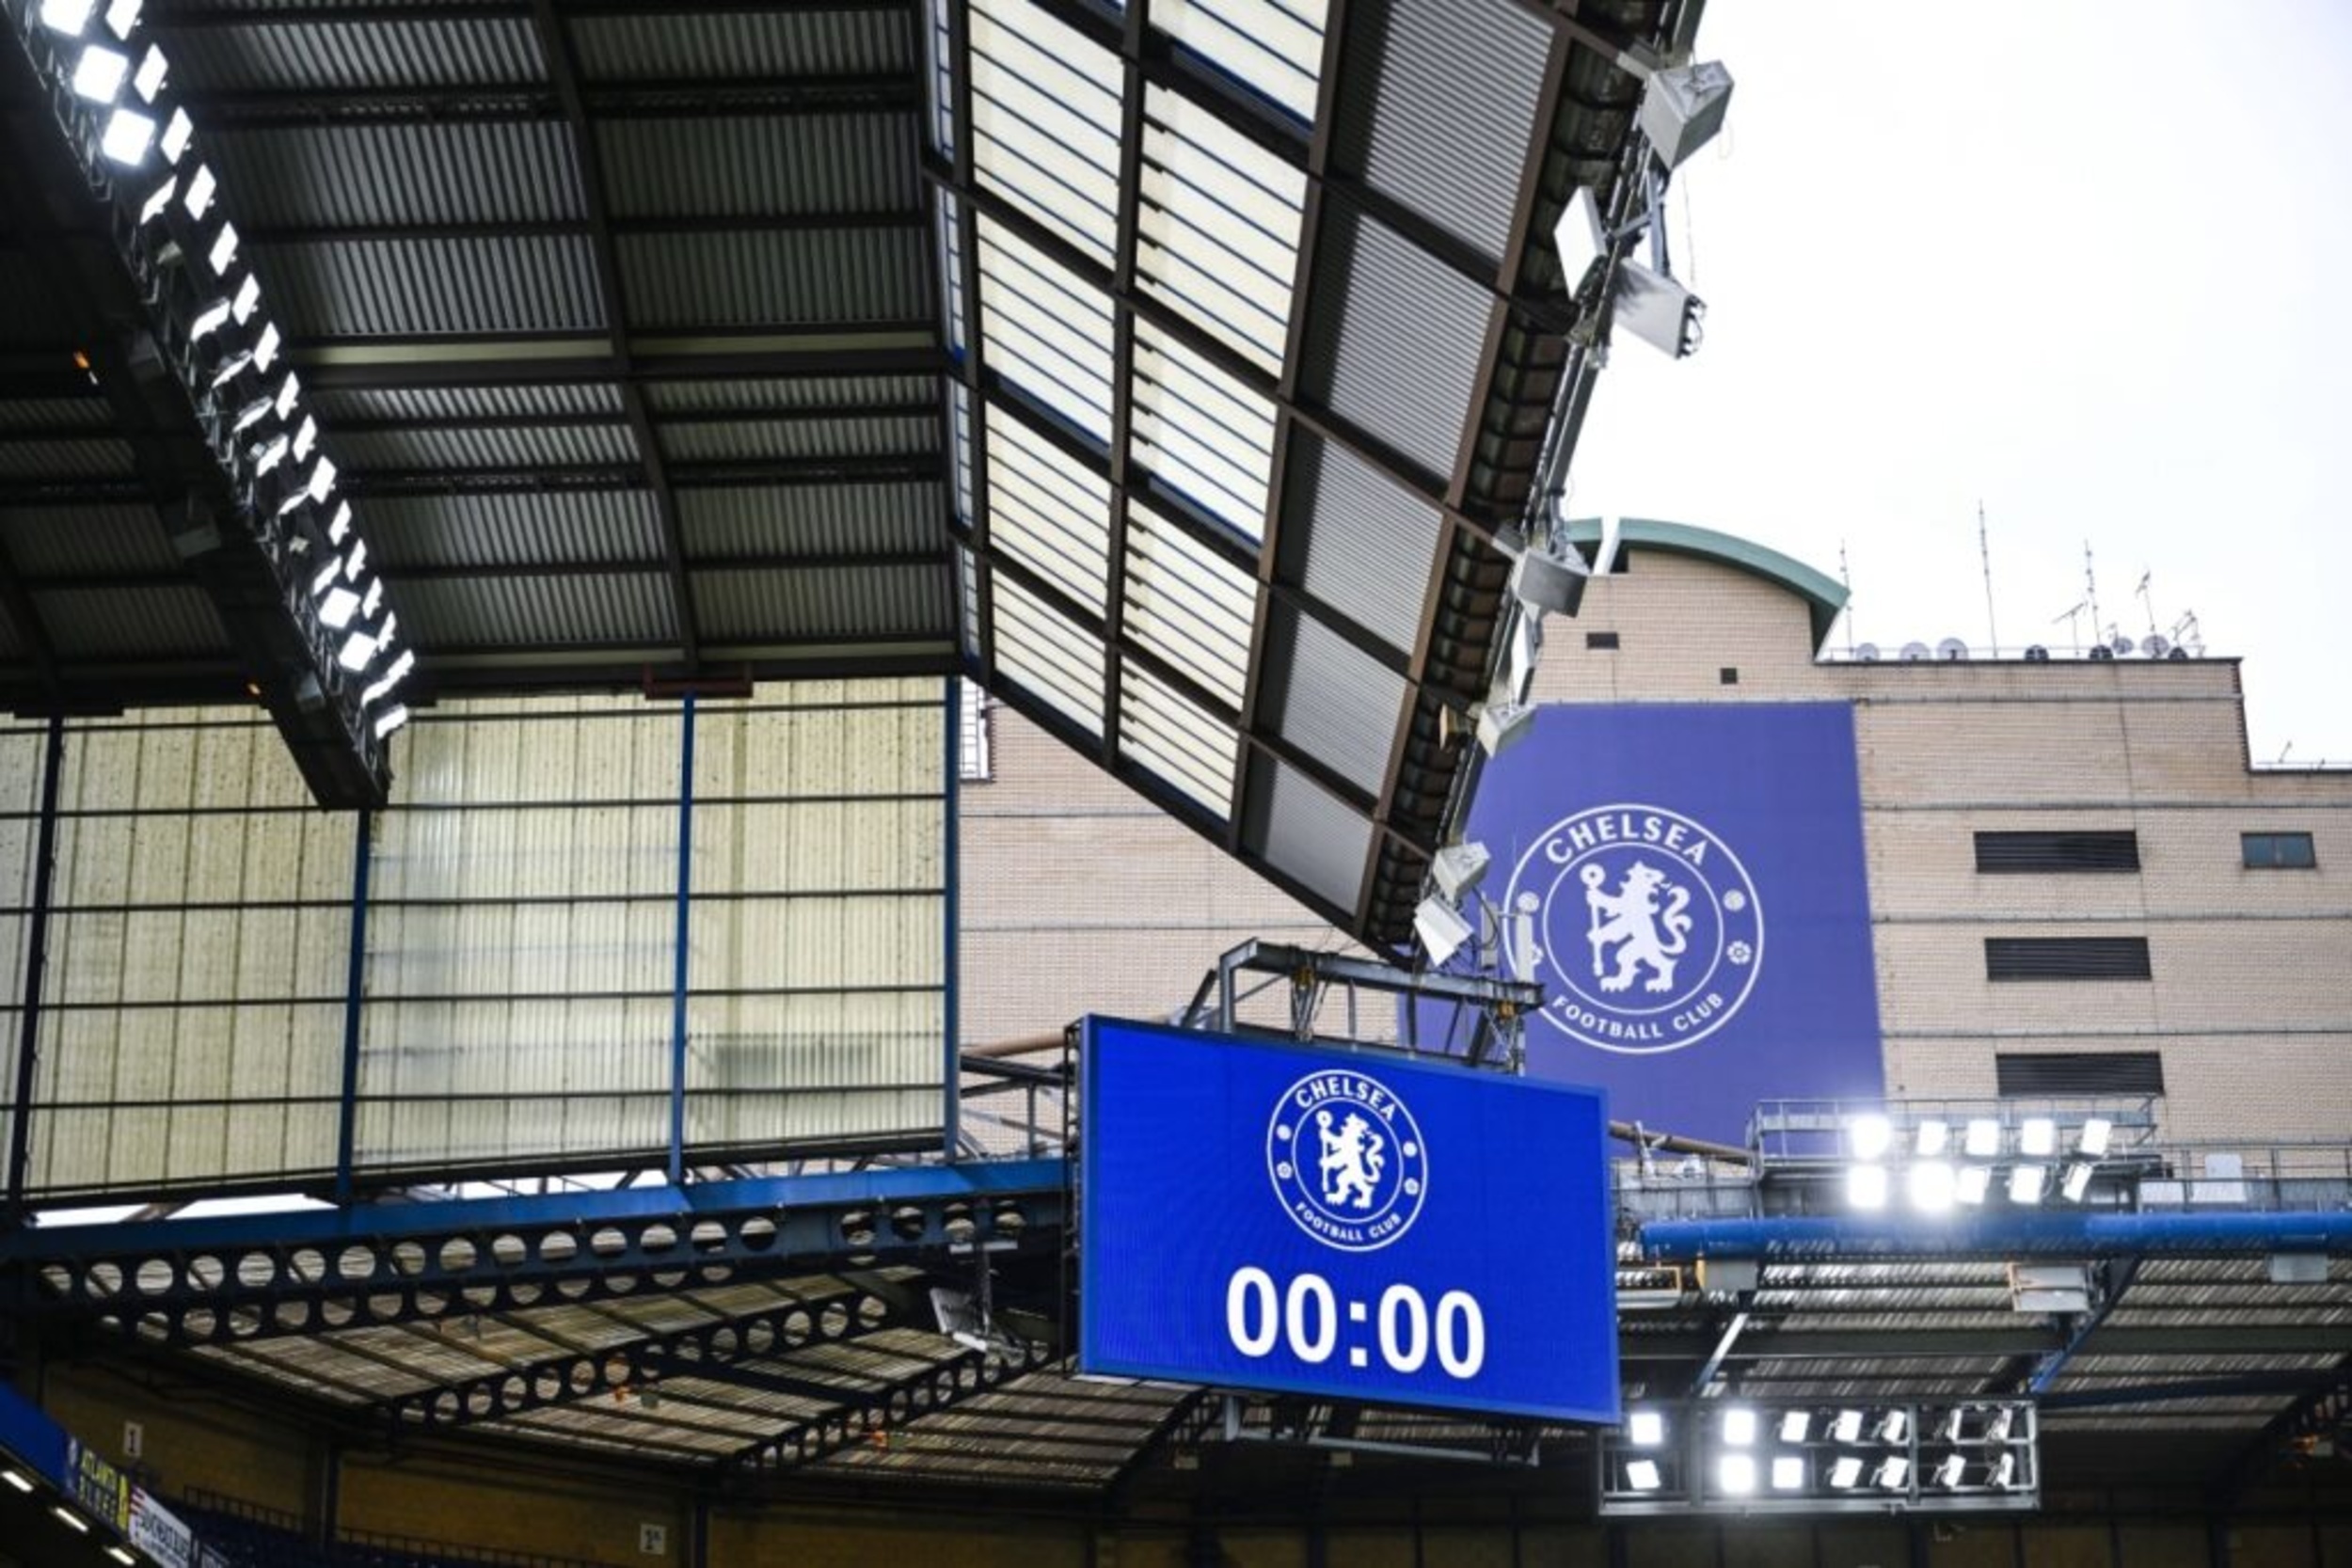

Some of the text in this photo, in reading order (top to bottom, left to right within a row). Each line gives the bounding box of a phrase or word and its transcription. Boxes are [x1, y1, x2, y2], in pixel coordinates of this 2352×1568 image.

[1546, 814, 1708, 866] CHELSEA
[1552, 992, 1723, 1039] FOOTBALL CLUB
[1295, 1076, 1397, 1120] CHELSEA
[1295, 1202, 1402, 1242] FOOTBALL CLUB
[1226, 1266, 1486, 1380] 00:00
